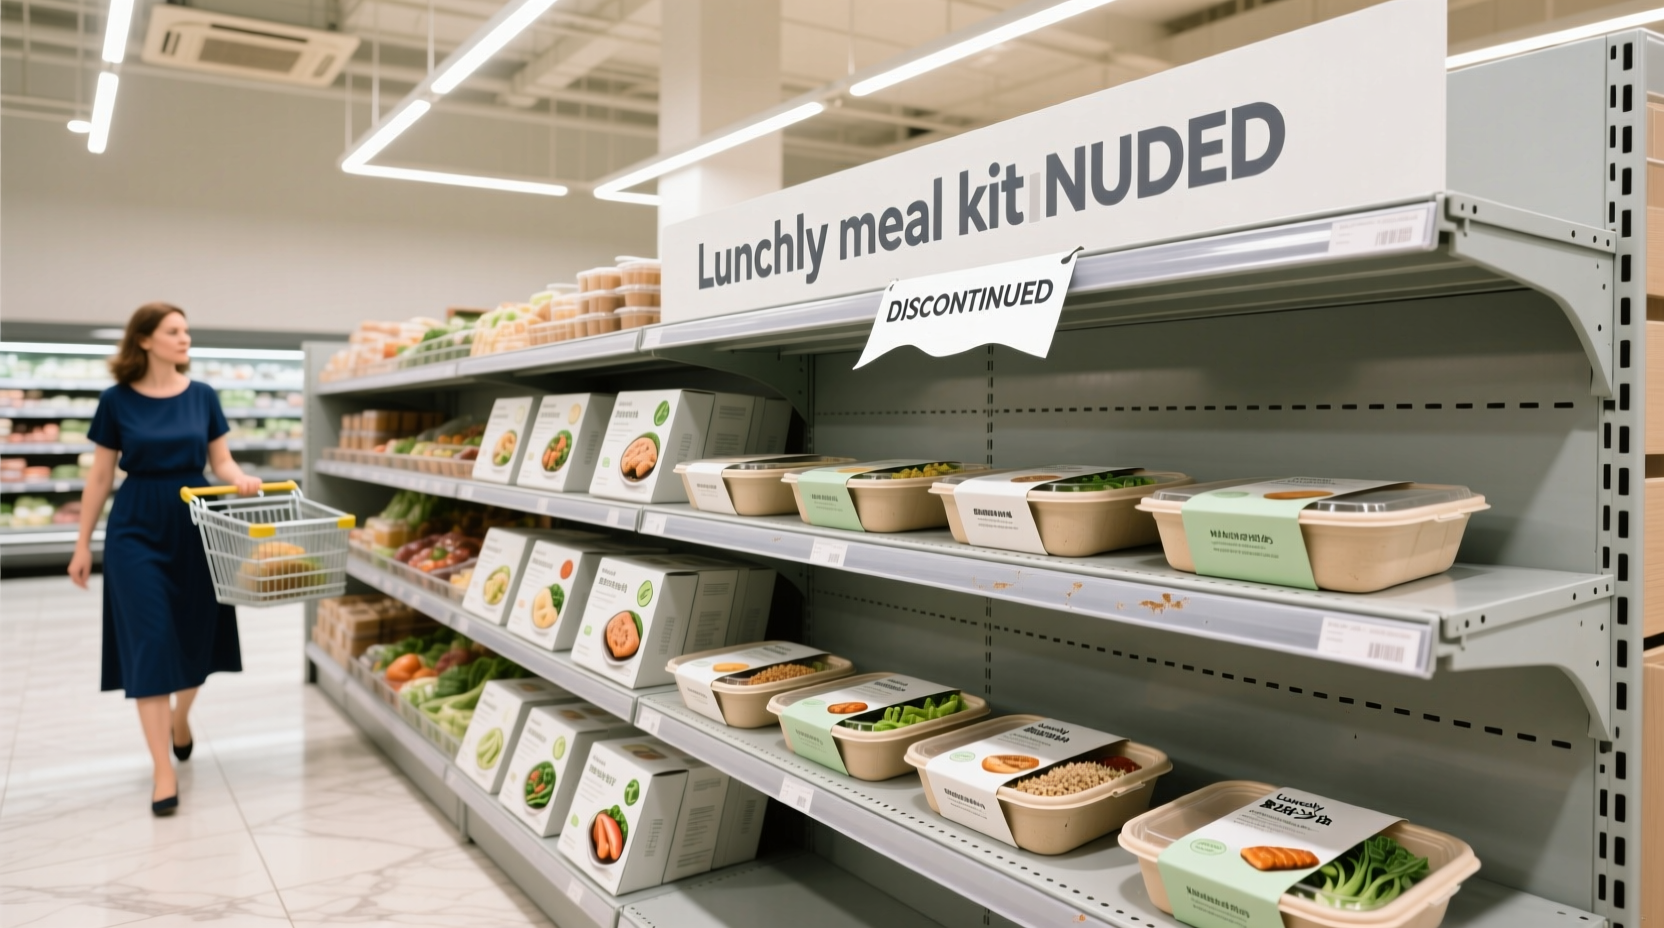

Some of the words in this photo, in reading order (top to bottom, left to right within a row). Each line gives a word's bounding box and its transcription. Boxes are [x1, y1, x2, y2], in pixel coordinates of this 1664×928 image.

[698, 212, 829, 290] Lunchly
[839, 176, 943, 261] meal
[958, 162, 1025, 236] kit
[1045, 101, 1286, 218] NUDED
[885, 279, 1054, 323] DISCONTINUED
